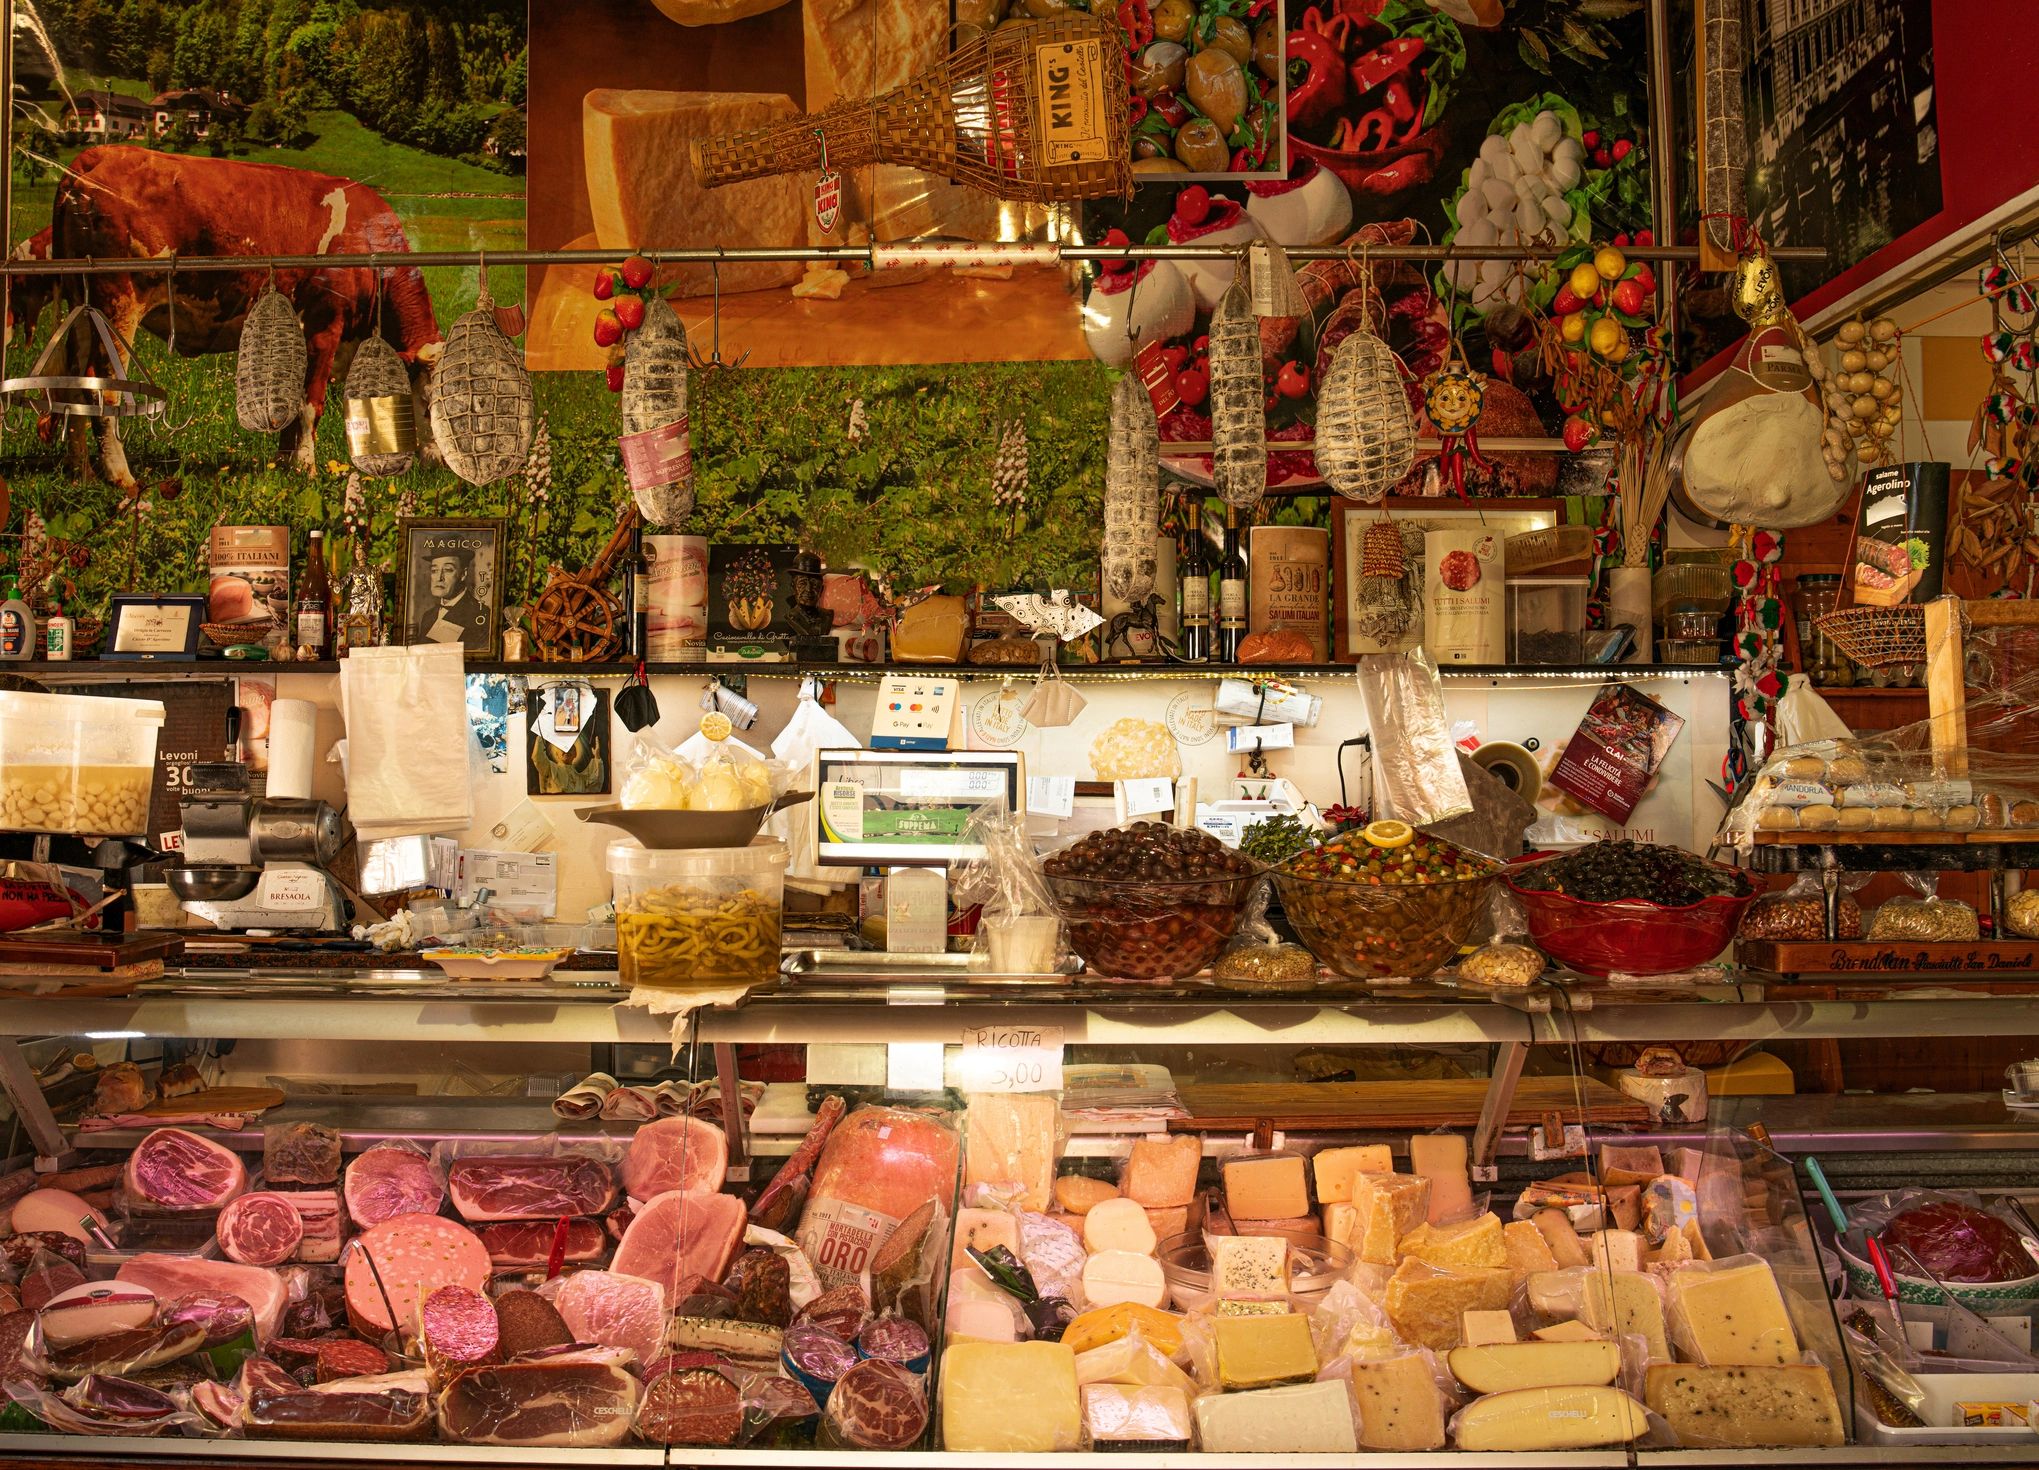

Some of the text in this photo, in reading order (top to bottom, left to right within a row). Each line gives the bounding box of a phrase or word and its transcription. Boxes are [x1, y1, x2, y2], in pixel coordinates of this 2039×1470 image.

[1755, 264, 1774, 293] LEVONI
[1875, 470, 1899, 480] salame
[1866, 479, 1911, 495] Agerolino
[423, 539, 482, 549] MAGICO
[237, 552, 279, 560] ITALIANI
[1269, 594, 1320, 603] LA GRANDE
[1459, 597, 1490, 605] SALUMI
[1269, 610, 1295, 620] SALUMI
[713, 631, 792, 643] Caciocavallo di Grotta
[899, 721, 910, 729] Pay
[923, 721, 934, 729] Pay
[992, 721, 1011, 733] ITALY
[1186, 721, 1204, 732] ITALY
[159, 749, 198, 761] Levoni
[1605, 746, 1624, 761] CLAI
[1590, 754, 1622, 778] LA FELICITÀ
[247, 770, 266, 779] Novit
[1587, 762, 1623, 787] CONDIVIDERE
[1592, 828, 1655, 842] SALUMI
[2, 890, 23, 901] NON
[270, 893, 311, 901] BRESAOLA
[977, 1030, 1041, 1049] RICOTTA
[830, 1222, 874, 1242] MORTADELLA
[827, 1230, 838, 1239] CON
[838, 1232, 872, 1249] PISTACCHIO
[819, 1237, 868, 1275] ORO
[830, 1267, 861, 1283] ITALIANO
[593, 1406, 633, 1415] CESCHELLI
